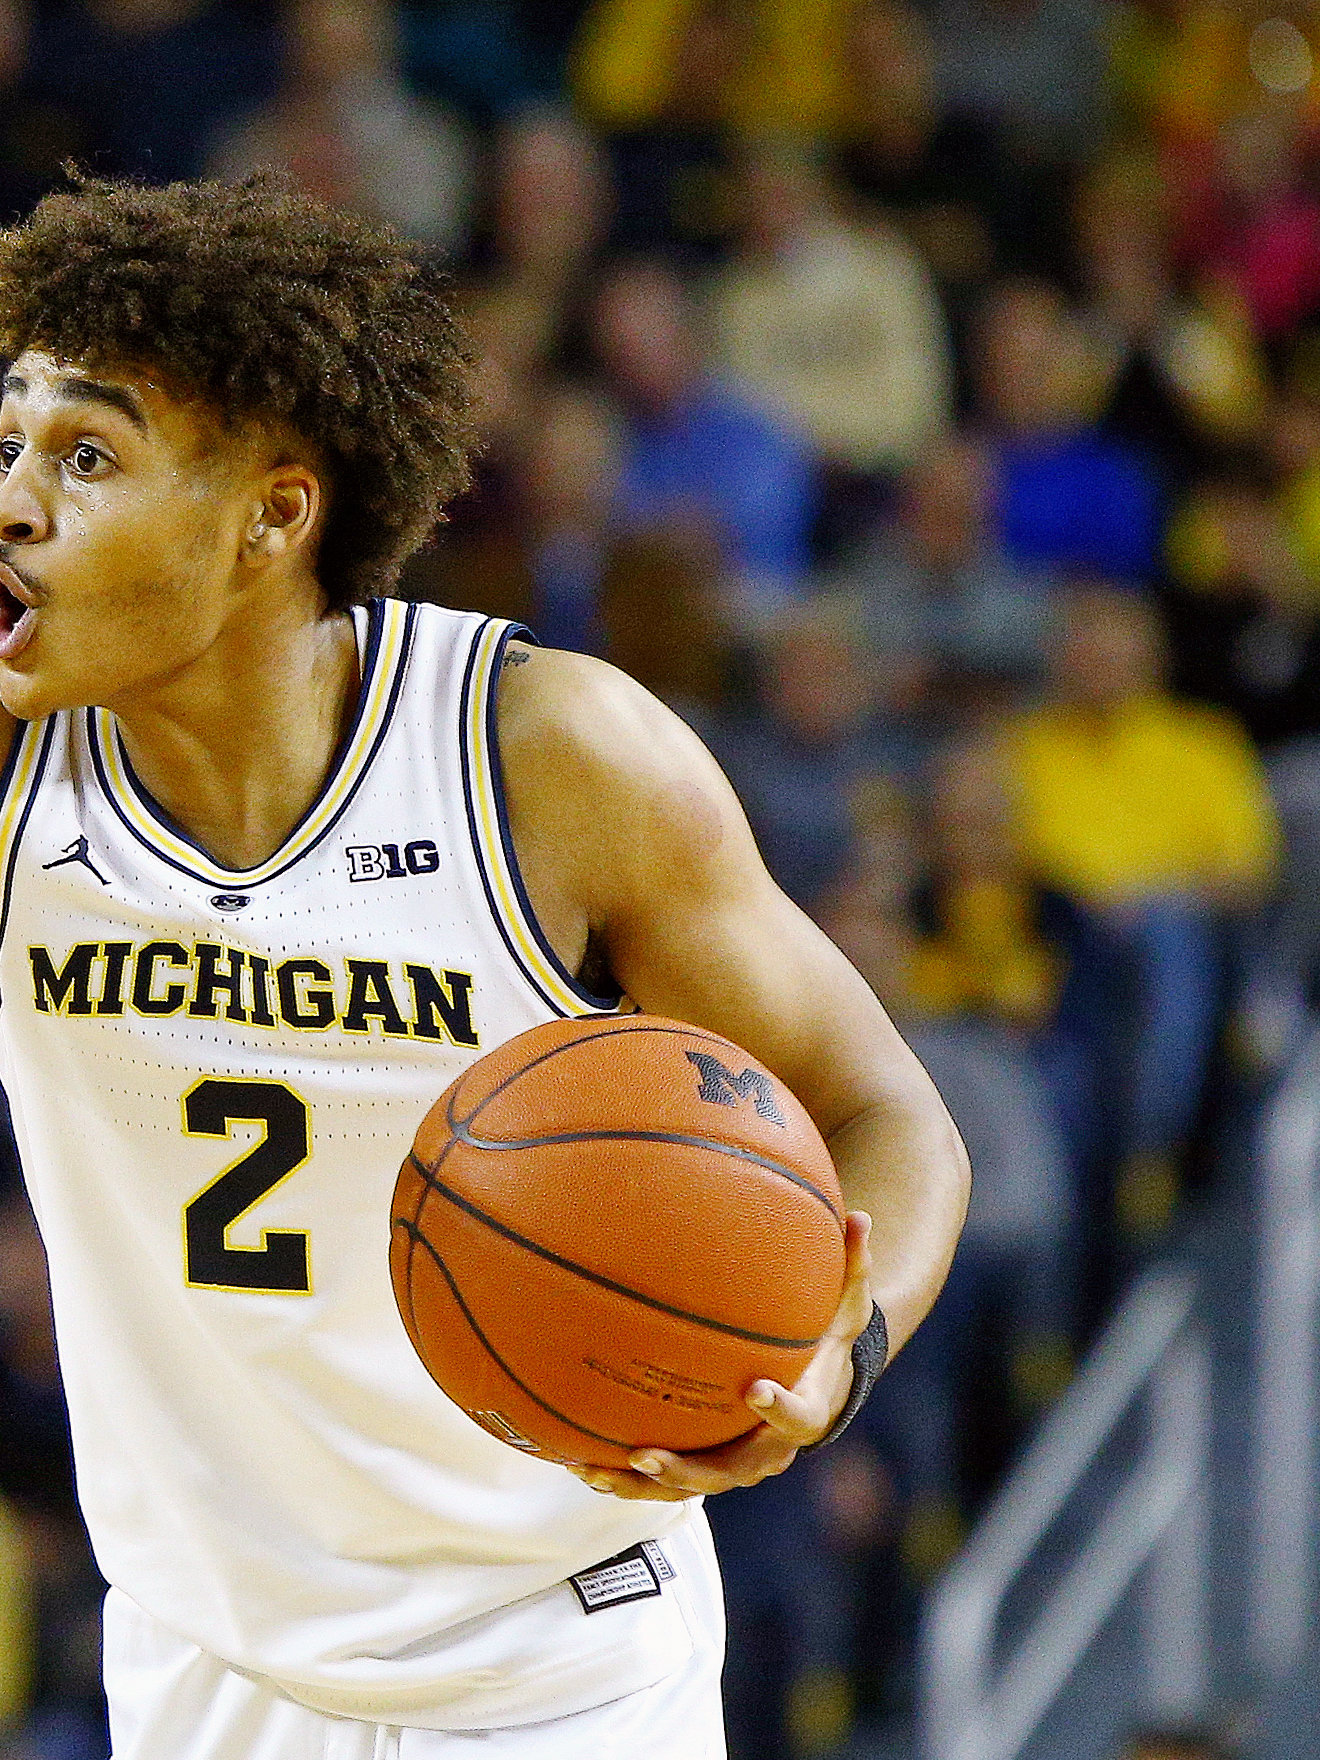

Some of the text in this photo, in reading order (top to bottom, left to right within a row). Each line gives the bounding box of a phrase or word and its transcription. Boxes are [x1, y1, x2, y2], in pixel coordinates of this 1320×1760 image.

[26, 939, 480, 1049] MICHIGAN
[685, 1051, 785, 1128] M
[181, 1075, 313, 1296] 2
